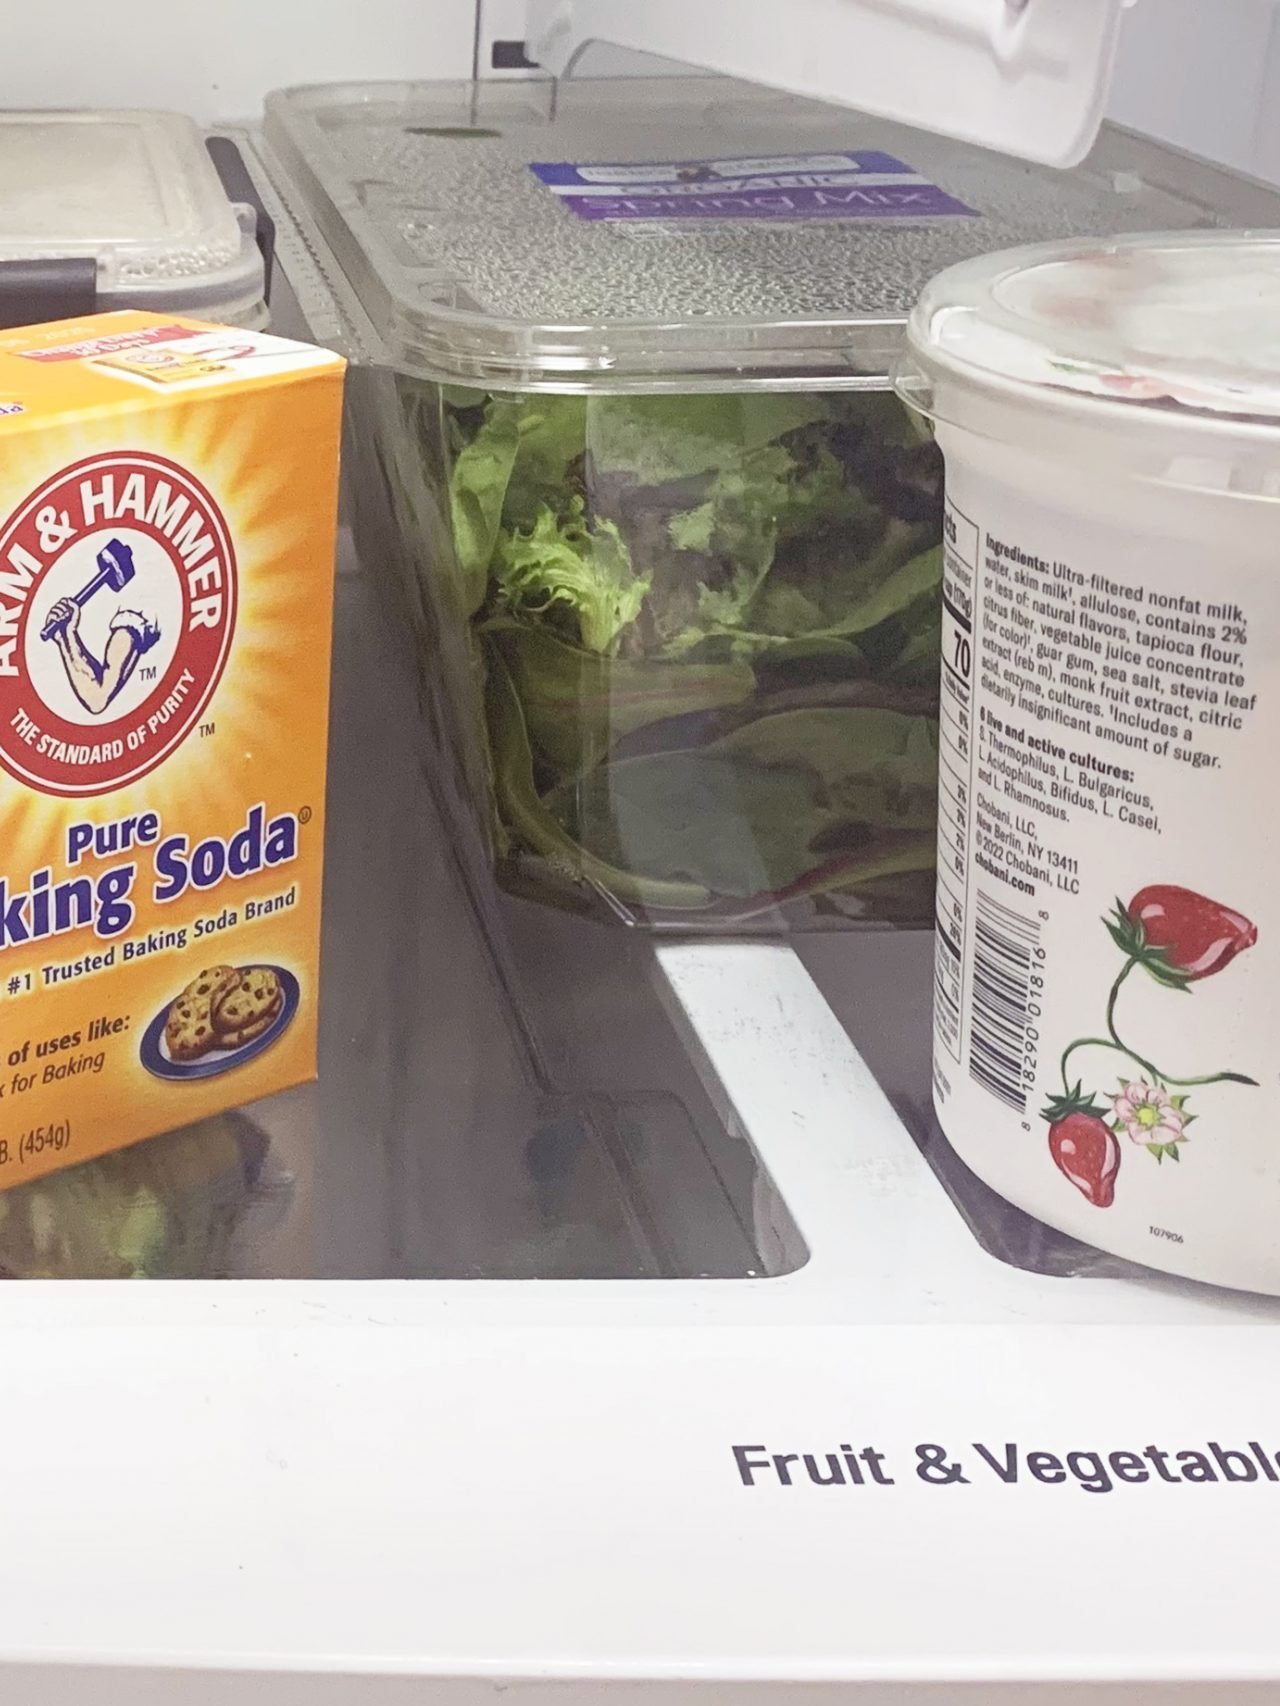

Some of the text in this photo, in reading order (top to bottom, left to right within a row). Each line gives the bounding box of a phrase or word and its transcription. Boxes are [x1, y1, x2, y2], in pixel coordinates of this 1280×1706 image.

[35, 505, 78, 553] &
[79, 472, 223, 633] HAMMER
[985, 532, 1050, 574] Ingredients:
[1053, 560, 1144, 602] Ultra-filtered
[1148, 591, 1201, 614] nonfat
[1206, 603, 1248, 626] milk,
[985, 556, 1012, 581] water,
[1014, 568, 1039, 590] skim
[1079, 594, 1141, 624] allulose,
[1145, 612, 1216, 640] contains
[1221, 625, 1248, 645] 2%
[994, 578, 1014, 600] less
[1032, 599, 1075, 625] natural
[1079, 611, 1131, 643] flavors,
[1136, 630, 1195, 657] tapioca
[1200, 642, 1244, 668] flour,
[954, 628, 970, 678] 70
[983, 595, 1009, 619] citrus
[1010, 607, 1037, 634] fiber,
[1040, 622, 1102, 654] vegetable
[1105, 640, 1142, 665] juice
[1146, 655, 1245, 688] concentrate
[1036, 642, 1257, 711] guar gum, sea salt, stevia leaf
[9, 668, 196, 765] THE STANDARD OF PURITY
[982, 636, 1243, 730] extract (reb m), monk fruit extract, citric
[1003, 669, 1045, 699] enzyme,
[1048, 688, 1105, 718] cultures.
[1183, 727, 1193, 742] a
[198, 722, 216, 738] TM
[980, 673, 1016, 708] dietarily
[1018, 696, 1091, 734] insignificant
[1095, 725, 1149, 752] amount
[1152, 740, 1170, 757] of
[1173, 746, 1222, 769] sugar.
[986, 708, 1135, 783] live and active cultures:
[977, 767, 1070, 823] and L. Rhamnosus.
[986, 751, 1162, 834] Acidophilus, Bifidus, L. Casei,
[988, 730, 1154, 811] Thermophilus, L. Bulgaricus,
[68, 812, 160, 862] Pure
[976, 811, 1078, 875] New Berlin, NY 13411
[977, 791, 1038, 841] Chobani, LLC,
[154, 806, 298, 902] Soda
[974, 850, 1036, 897] chobani.com
[1005, 849, 1053, 887] Chobani,
[1056, 873, 1080, 895] LLC
[7, 973, 32, 996] #1
[42, 946, 116, 984] Trusted
[122, 926, 187, 962] Baking
[193, 908, 238, 938] Soda
[245, 886, 297, 921] Brand
[7, 1041, 31, 1067] of
[36, 1028, 81, 1058] uses
[87, 1014, 131, 1044] like:
[1021, 910, 1050, 1132] 8 18290 01816 8
[10, 1072, 38, 1096] for
[42, 1051, 106, 1085] Baking
[19, 1119, 72, 1164] (454g)
[1148, 1224, 1185, 1245] 107906
[731, 1441, 1280, 1493] Fruit & Vegetabl
